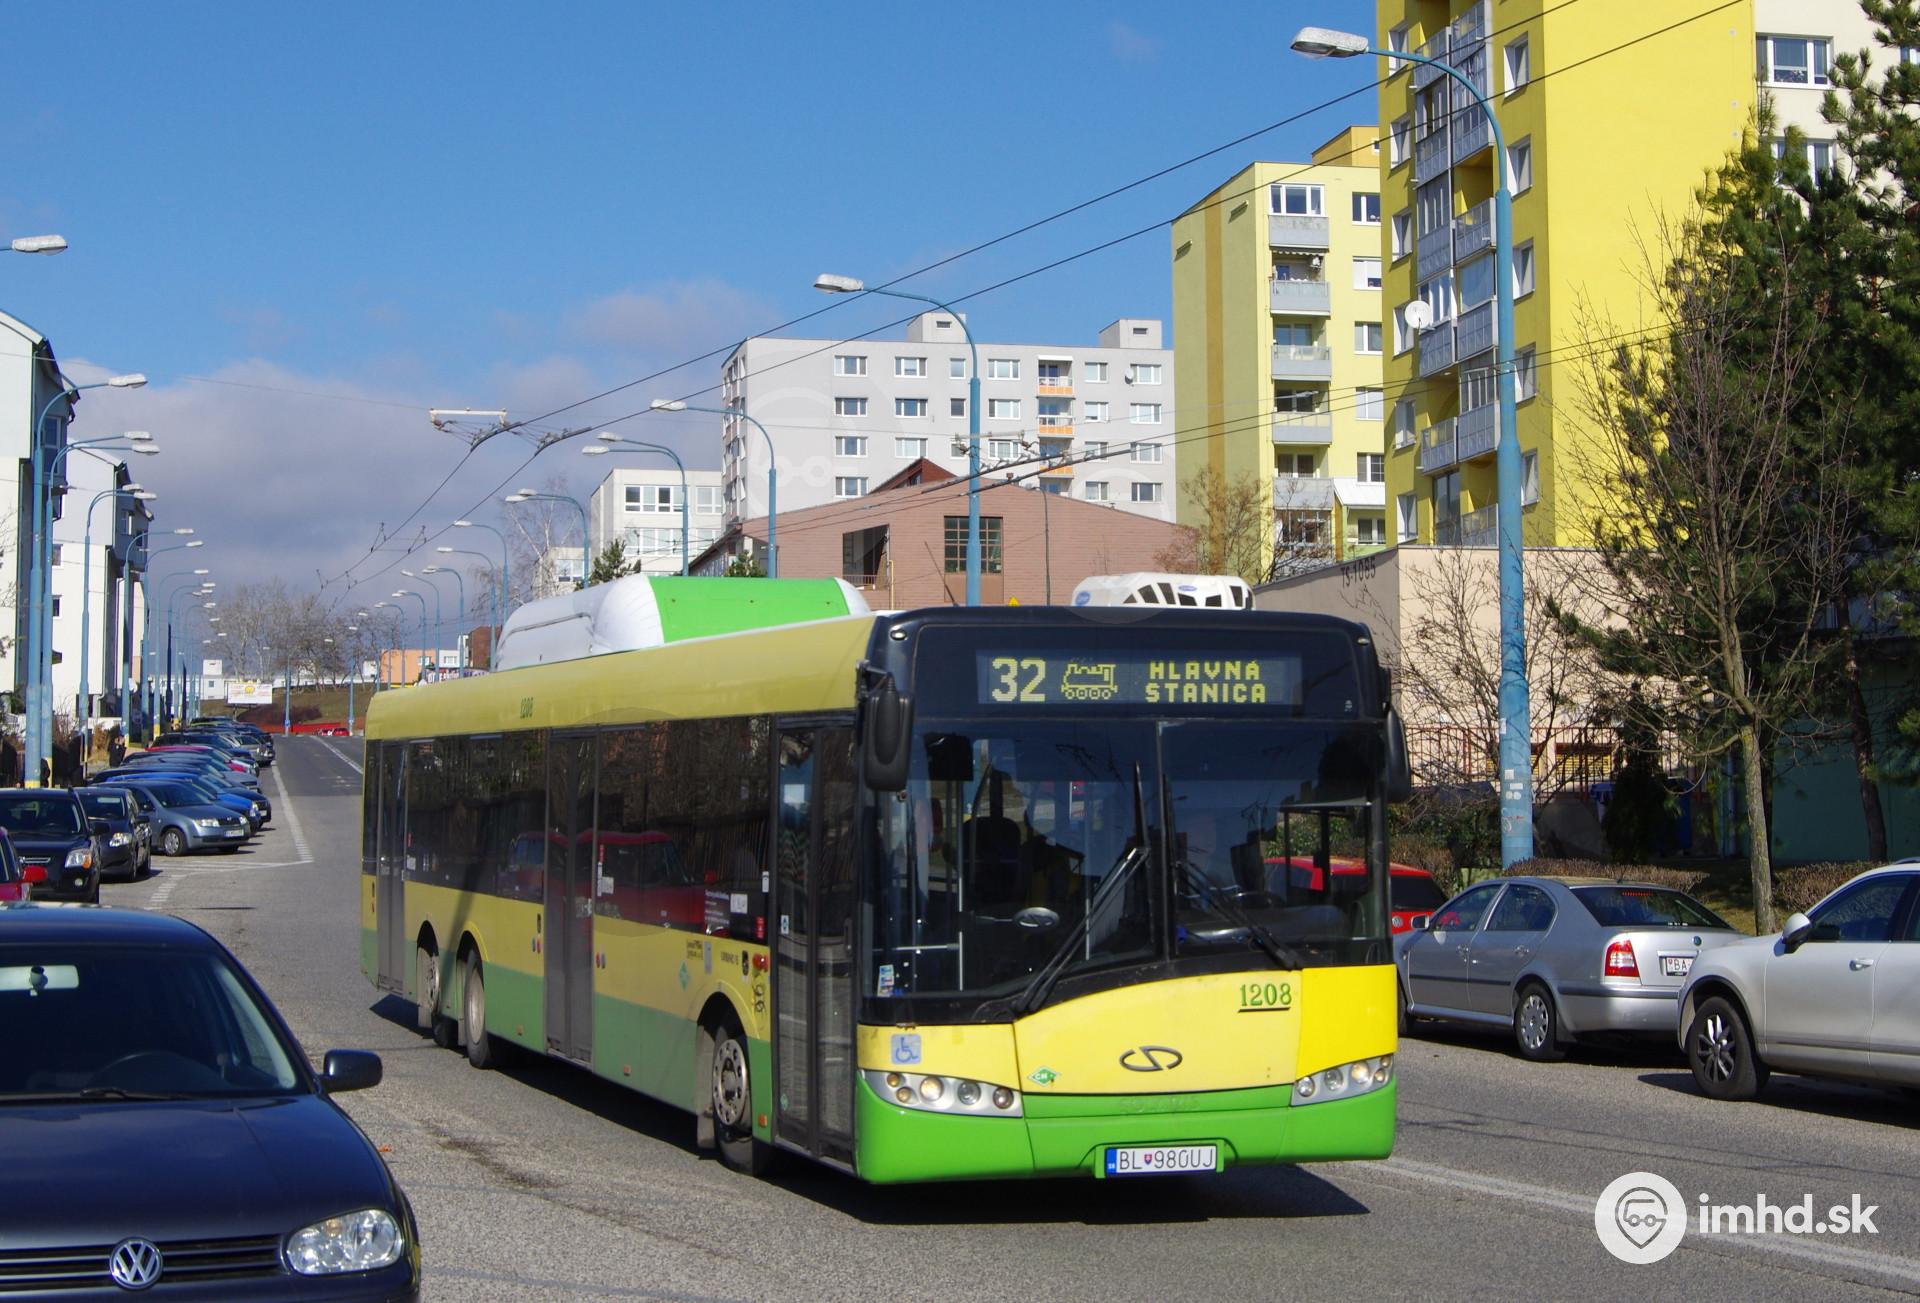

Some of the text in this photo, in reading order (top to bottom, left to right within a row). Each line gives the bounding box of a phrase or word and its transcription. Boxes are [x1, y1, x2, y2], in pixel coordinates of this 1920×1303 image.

[1340, 556, 1376, 589] TS-1085
[992, 657, 1046, 701] 32
[1150, 660, 1260, 680] HLAVNÁ
[1145, 682, 1266, 703] STANICA
[1239, 983, 1292, 1007] 1208
[1119, 1148, 1213, 1170] BL 980UJ
